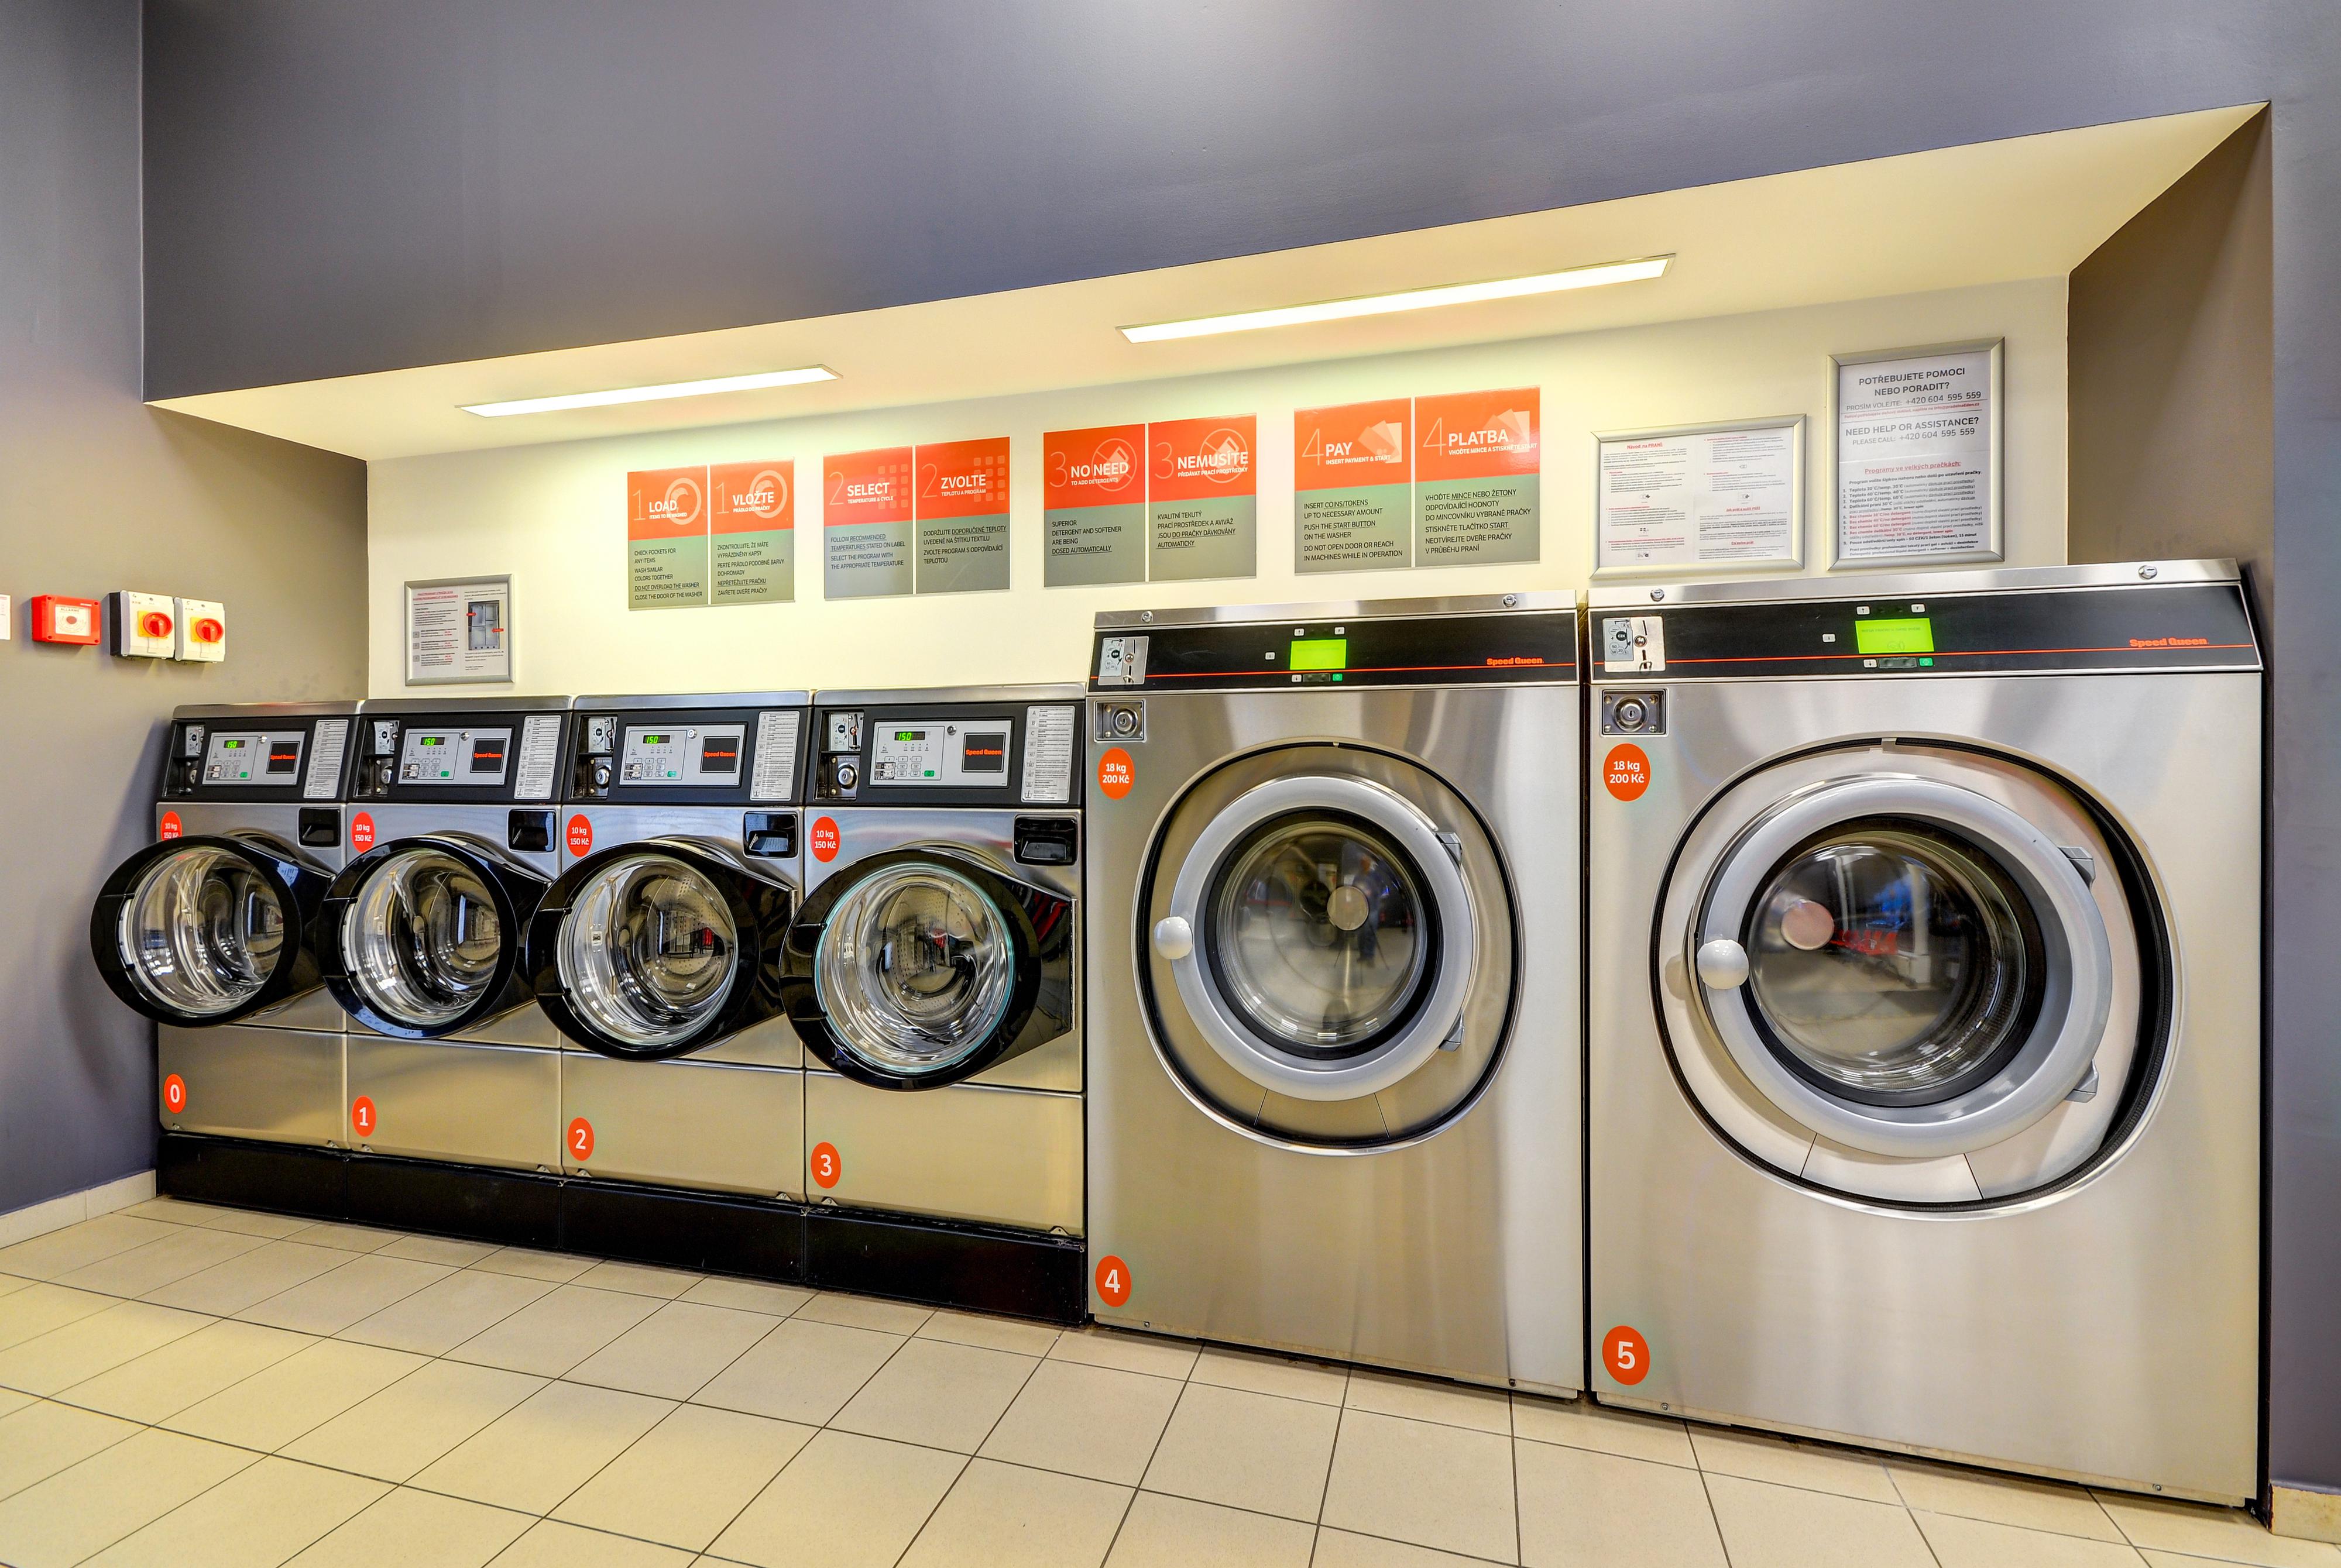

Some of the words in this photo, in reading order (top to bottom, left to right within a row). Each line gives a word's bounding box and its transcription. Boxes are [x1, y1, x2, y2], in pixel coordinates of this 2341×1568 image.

[1859, 372, 1923, 385] POTŘEBUJETE
[1926, 368, 1965, 379] POMOCI
[1875, 387, 1900, 396] NEBO
[1903, 382, 1950, 393] PORADIT?
[1846, 403, 1870, 411] PROSÍM
[1948, 393, 1962, 401] 595
[1966, 391, 1981, 400] 559
[1846, 427, 1869, 436] NEED
[1873, 425, 1896, 433] HELP
[1915, 417, 1979, 429] ASSISTANCE?
[1423, 417, 1446, 456] 4
[1448, 429, 1508, 446] PLATBA
[1302, 428, 1324, 466] 4
[1326, 442, 1352, 457] PAY
[1178, 451, 1248, 469] NEMUSÍTE
[1071, 465, 1090, 478] NO
[1093, 462, 1128, 476] NEED
[941, 474, 986, 489] ZVOLTE
[847, 482, 890, 497] SELECT
[1451, 491, 1471, 499] MINCE
[1491, 489, 1516, 497] ŽETONY
[733, 491, 774, 506] VLOŽTE
[1324, 500, 1368, 508] COINS/TOKENS
[649, 500, 677, 513] LOAD
[1436, 511, 1475, 520] MINCOVNÍKU
[1476, 510, 1505, 518] VYBRANÉ
[1506, 508, 1530, 516] PRAČKY
[2129, 638, 2167, 648] Speed
[2168, 637, 2207, 646] Queen
[1487, 657, 1514, 666] Speed
[898, 732, 912, 741] 150
[1106, 763, 1115, 772] 18
[1116, 763, 1126, 773] kg
[1614, 761, 1625, 771] 18
[1627, 761, 1640, 772] kg
[1102, 775, 1118, 783] 200
[1119, 775, 1130, 783] Kč
[1609, 773, 1629, 783] 200
[1631, 773, 1645, 783] Kč
[363, 824, 370, 833] kg
[579, 827, 587, 835] kg
[825, 830, 833, 839] kg
[170, 1084, 180, 1103] 0
[359, 1107, 368, 1126] 1
[575, 1129, 586, 1150] 2
[820, 1154, 832, 1177] 3
[1105, 1269, 1120, 1293] 4
[1618, 1341, 1635, 1369] 5
